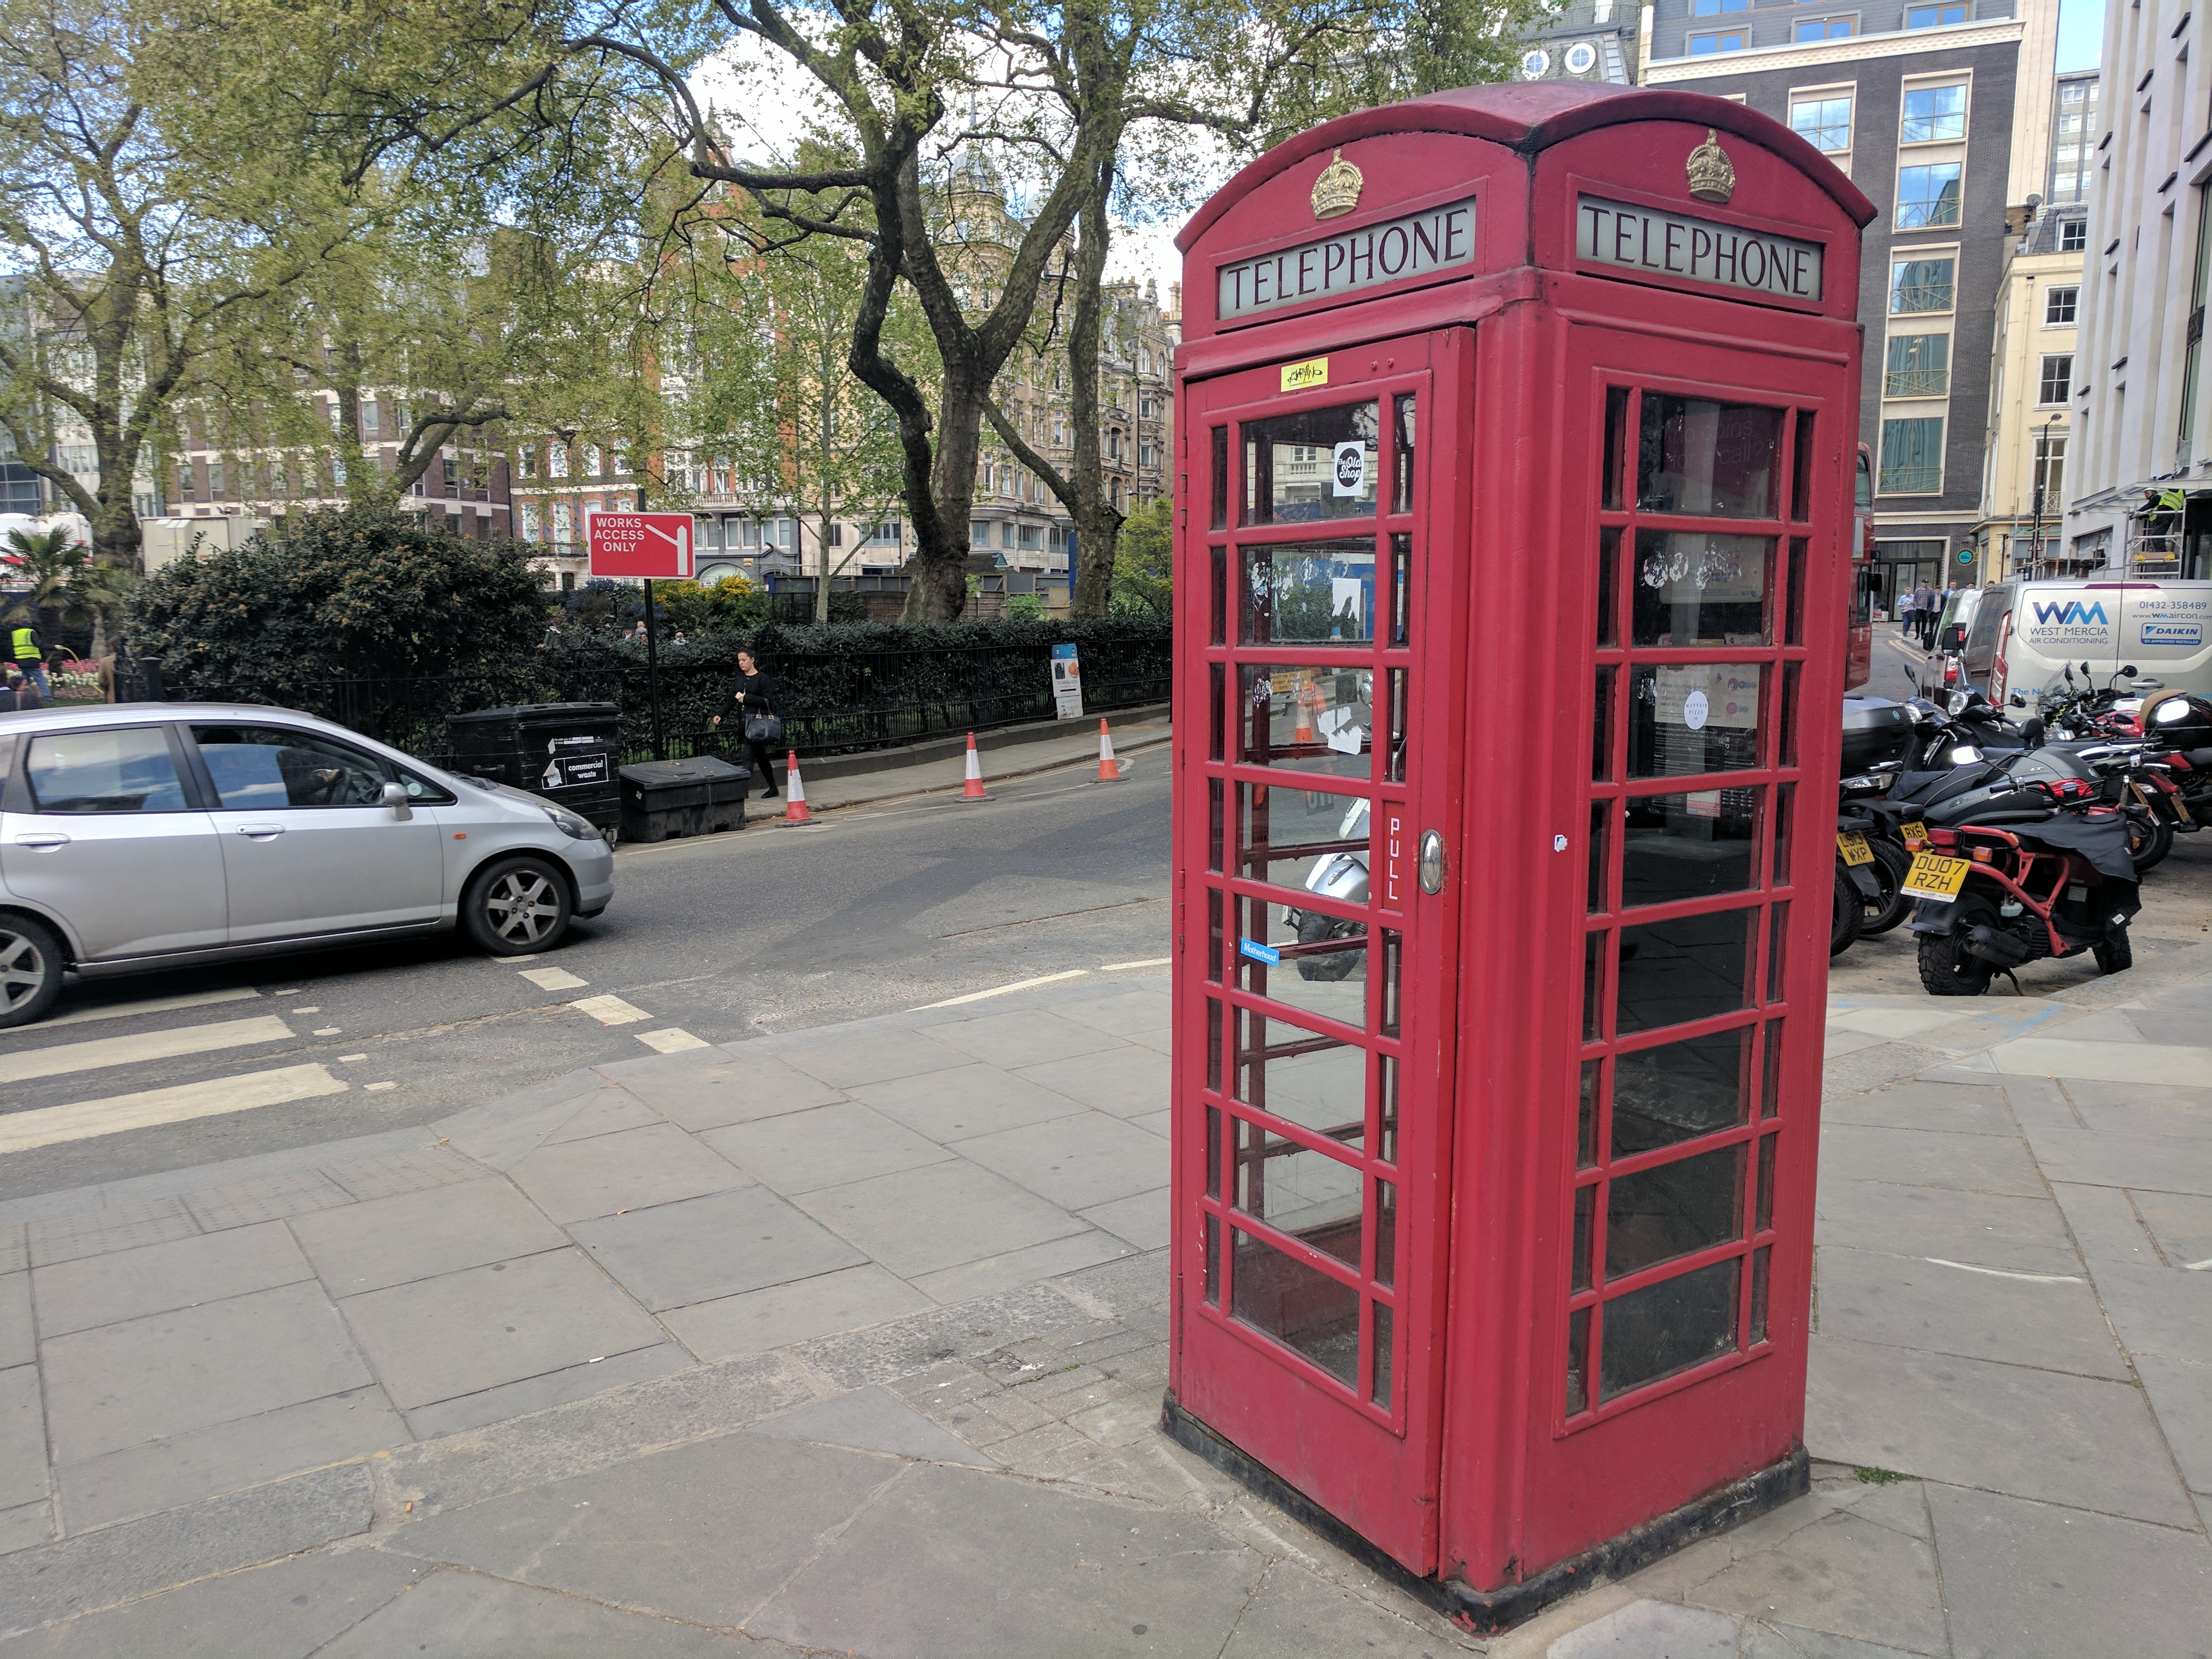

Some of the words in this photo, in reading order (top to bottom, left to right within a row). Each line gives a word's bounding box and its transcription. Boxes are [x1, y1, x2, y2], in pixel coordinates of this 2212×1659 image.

[1581, 205, 1811, 295] TELEPHONE
[1227, 208, 1468, 310] TELEPHONE
[1346, 456, 1362, 468] Old
[1339, 464, 1361, 481] Shop
[596, 517, 642, 528] WORKS
[594, 530, 645, 540] ACCESS
[603, 542, 637, 552] ONLY
[2032, 601, 2109, 625] WM
[2139, 601, 2207, 610] 01432-358489
[2029, 627, 2062, 636] WEST
[2064, 627, 2108, 636] MERCIA
[568, 760, 603, 772] commercial
[578, 770, 597, 779] waste
[1838, 831, 1864, 848] LS13
[1389, 817, 1400, 900] PULL
[1915, 856, 1966, 875] DU07
[1914, 872, 1952, 891] RZH
[1244, 942, 1276, 962] Motherhood
